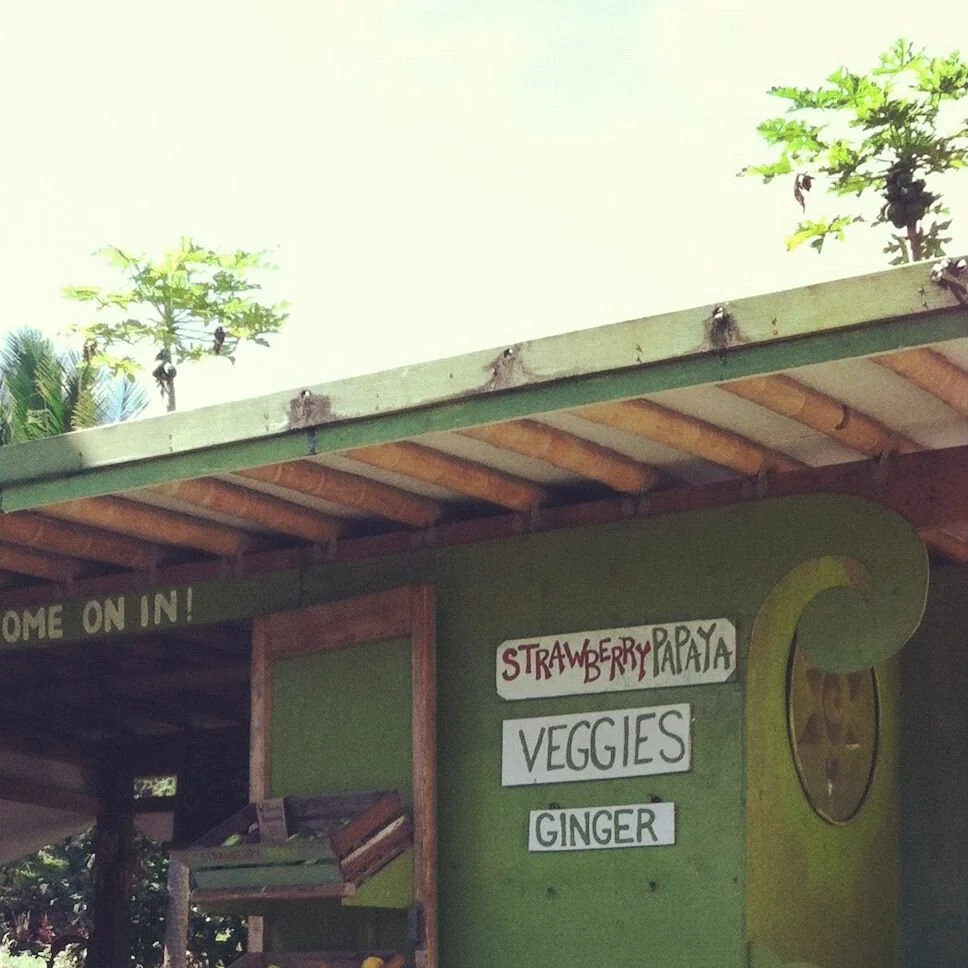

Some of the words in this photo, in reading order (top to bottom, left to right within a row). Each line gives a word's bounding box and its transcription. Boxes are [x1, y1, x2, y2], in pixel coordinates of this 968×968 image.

[82, 596, 125, 635] ON
[140, 587, 193, 628] IN!
[502, 636, 652, 684] STRAWBERRY
[652, 623, 733, 678] PAPAYA
[518, 710, 686, 773] VEGGIES
[535, 808, 659, 848] GINGER
